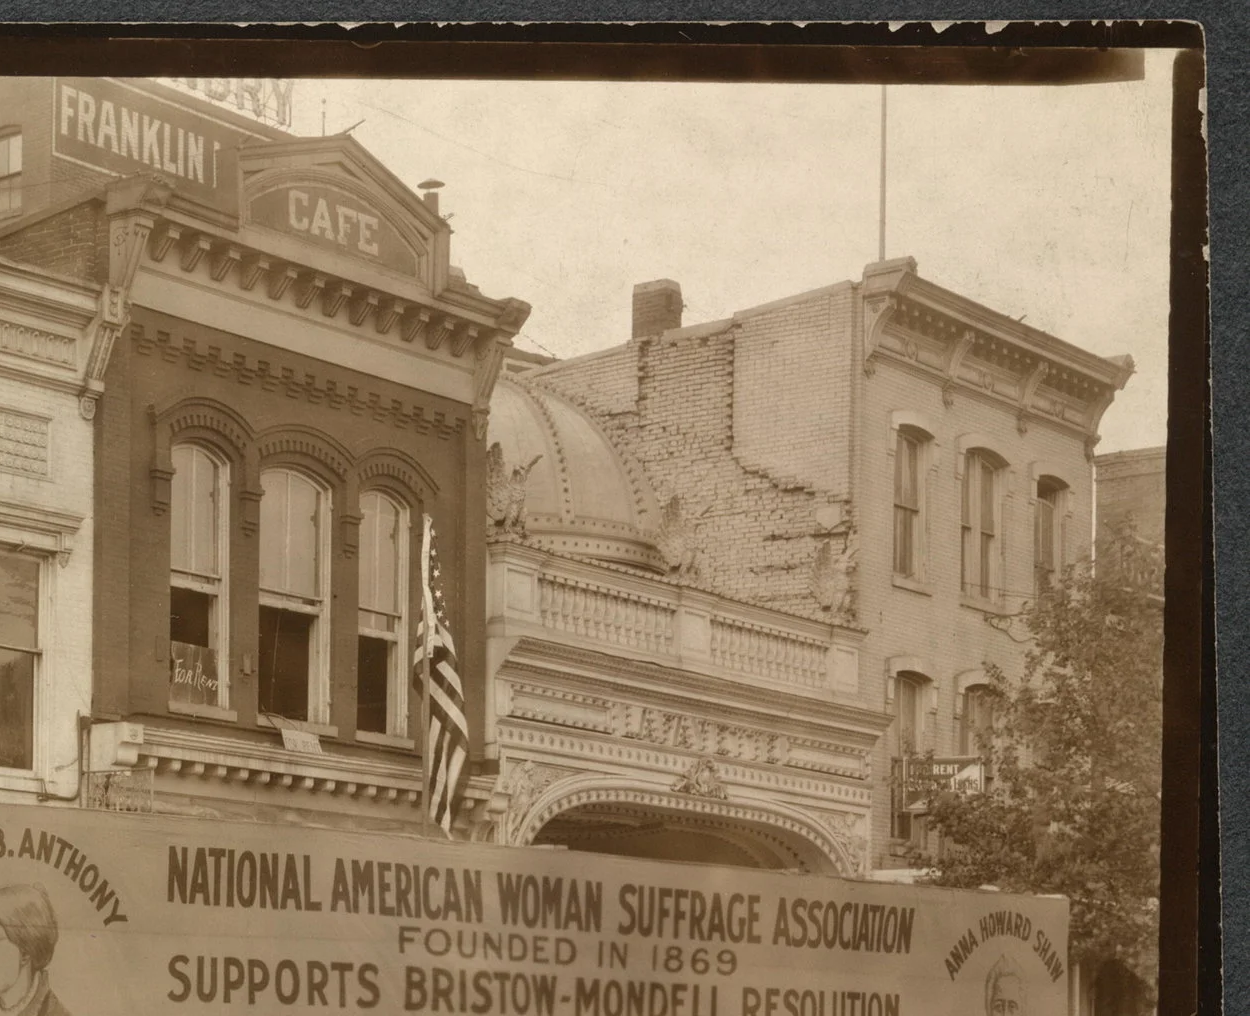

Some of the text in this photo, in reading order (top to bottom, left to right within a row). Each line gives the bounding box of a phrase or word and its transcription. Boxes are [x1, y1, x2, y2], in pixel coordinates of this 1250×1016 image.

[60, 84, 205, 184] FRANKLIN
[288, 189, 379, 256] CAFE
[933, 764, 959, 775] RENT
[19, 829, 129, 926] ANTHONY
[168, 845, 915, 954] NATIONAL AMERICAN WOMAN SUFFRAGE ASSOCIATION
[398, 926, 738, 976] FOUNDED IN 1869
[944, 910, 1064, 983] ANNA HOWARD SHAW
[168, 955, 381, 1009] SUPPORTS
